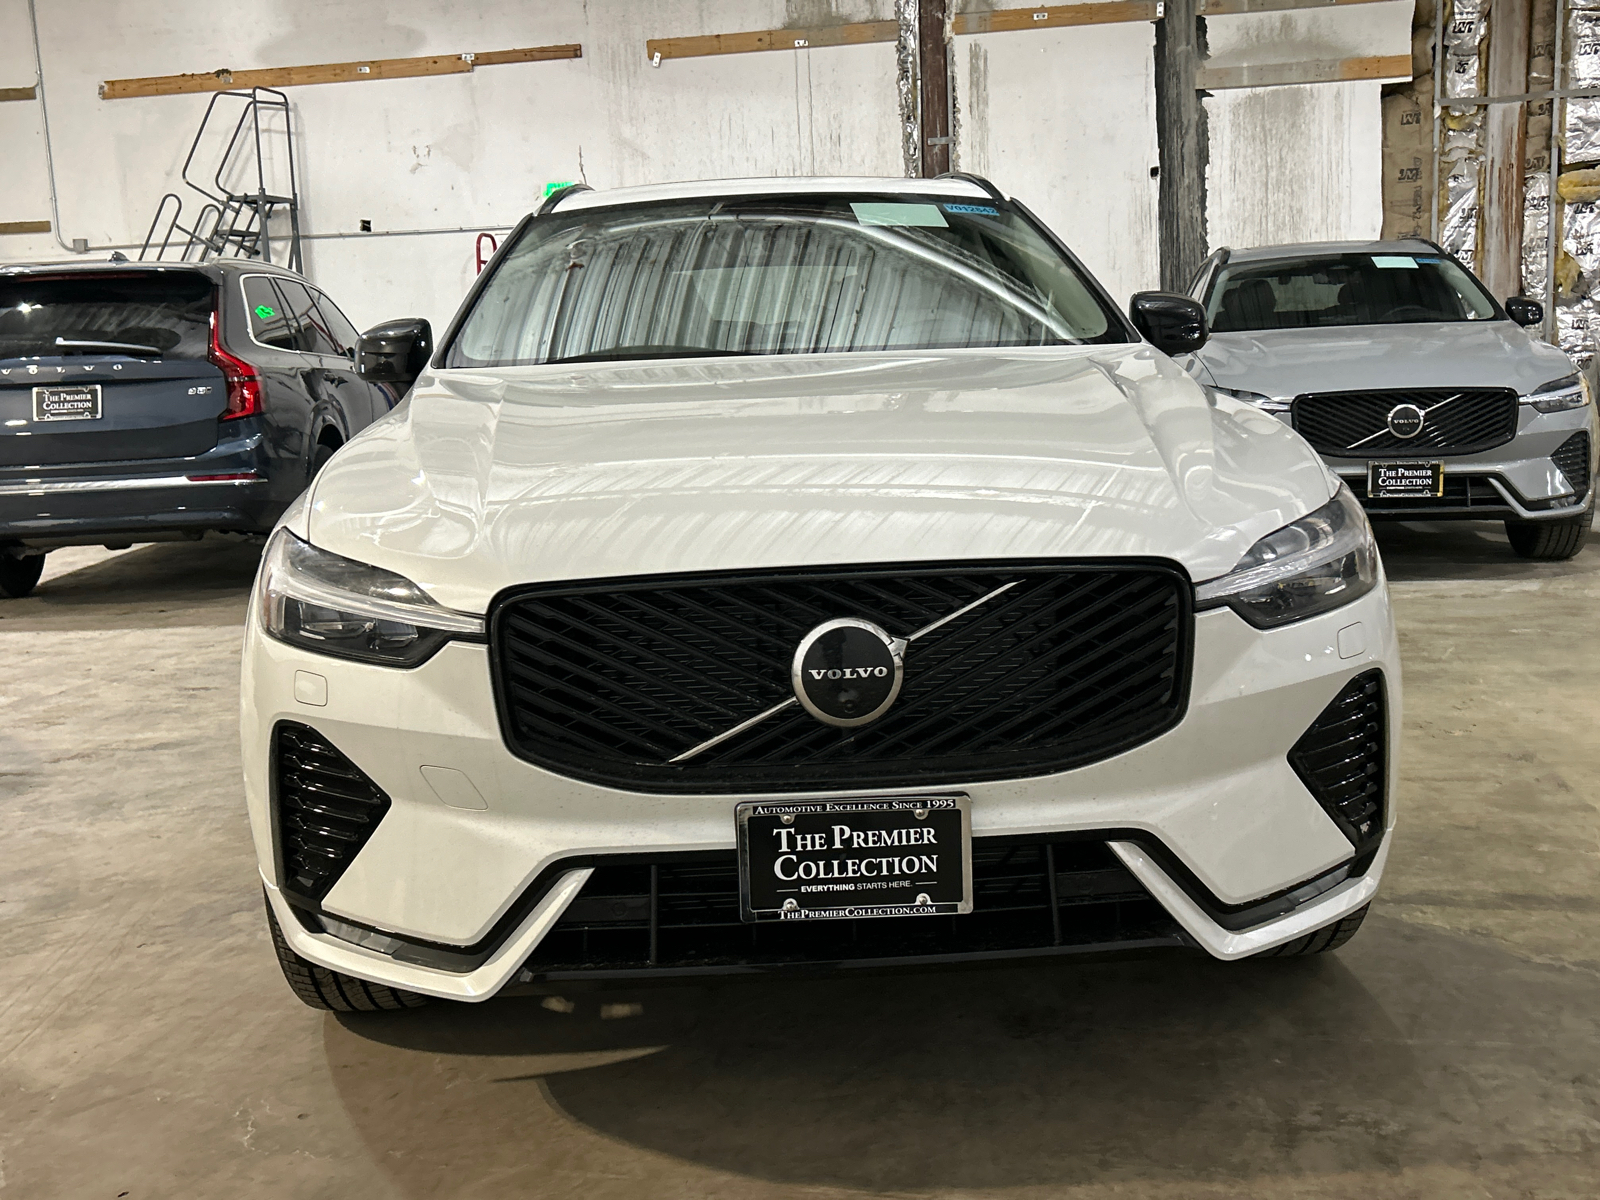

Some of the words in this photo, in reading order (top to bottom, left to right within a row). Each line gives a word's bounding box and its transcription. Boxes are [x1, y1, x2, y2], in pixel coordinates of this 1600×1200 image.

[42, 393, 59, 402] THE
[60, 392, 92, 401] PREMIER
[42, 401, 92, 410] COLLECTION
[1378, 468, 1397, 477] THE
[1398, 468, 1432, 477] PREMIER
[1378, 477, 1432, 486] COLLECTION
[808, 666, 888, 680] VOLVO
[755, 805, 823, 815] AUTOMOTIVE
[825, 802, 889, 812] EXCELLENCE
[891, 801, 923, 810] SINCE
[926, 799, 954, 808] 1995
[772, 827, 828, 853] THE
[831, 825, 938, 849] PREMIER
[773, 854, 939, 881] COLLECTION
[801, 883, 855, 893] EVERYTHING
[856, 881, 887, 891] STARTS
[888, 880, 913, 889] HERE.
